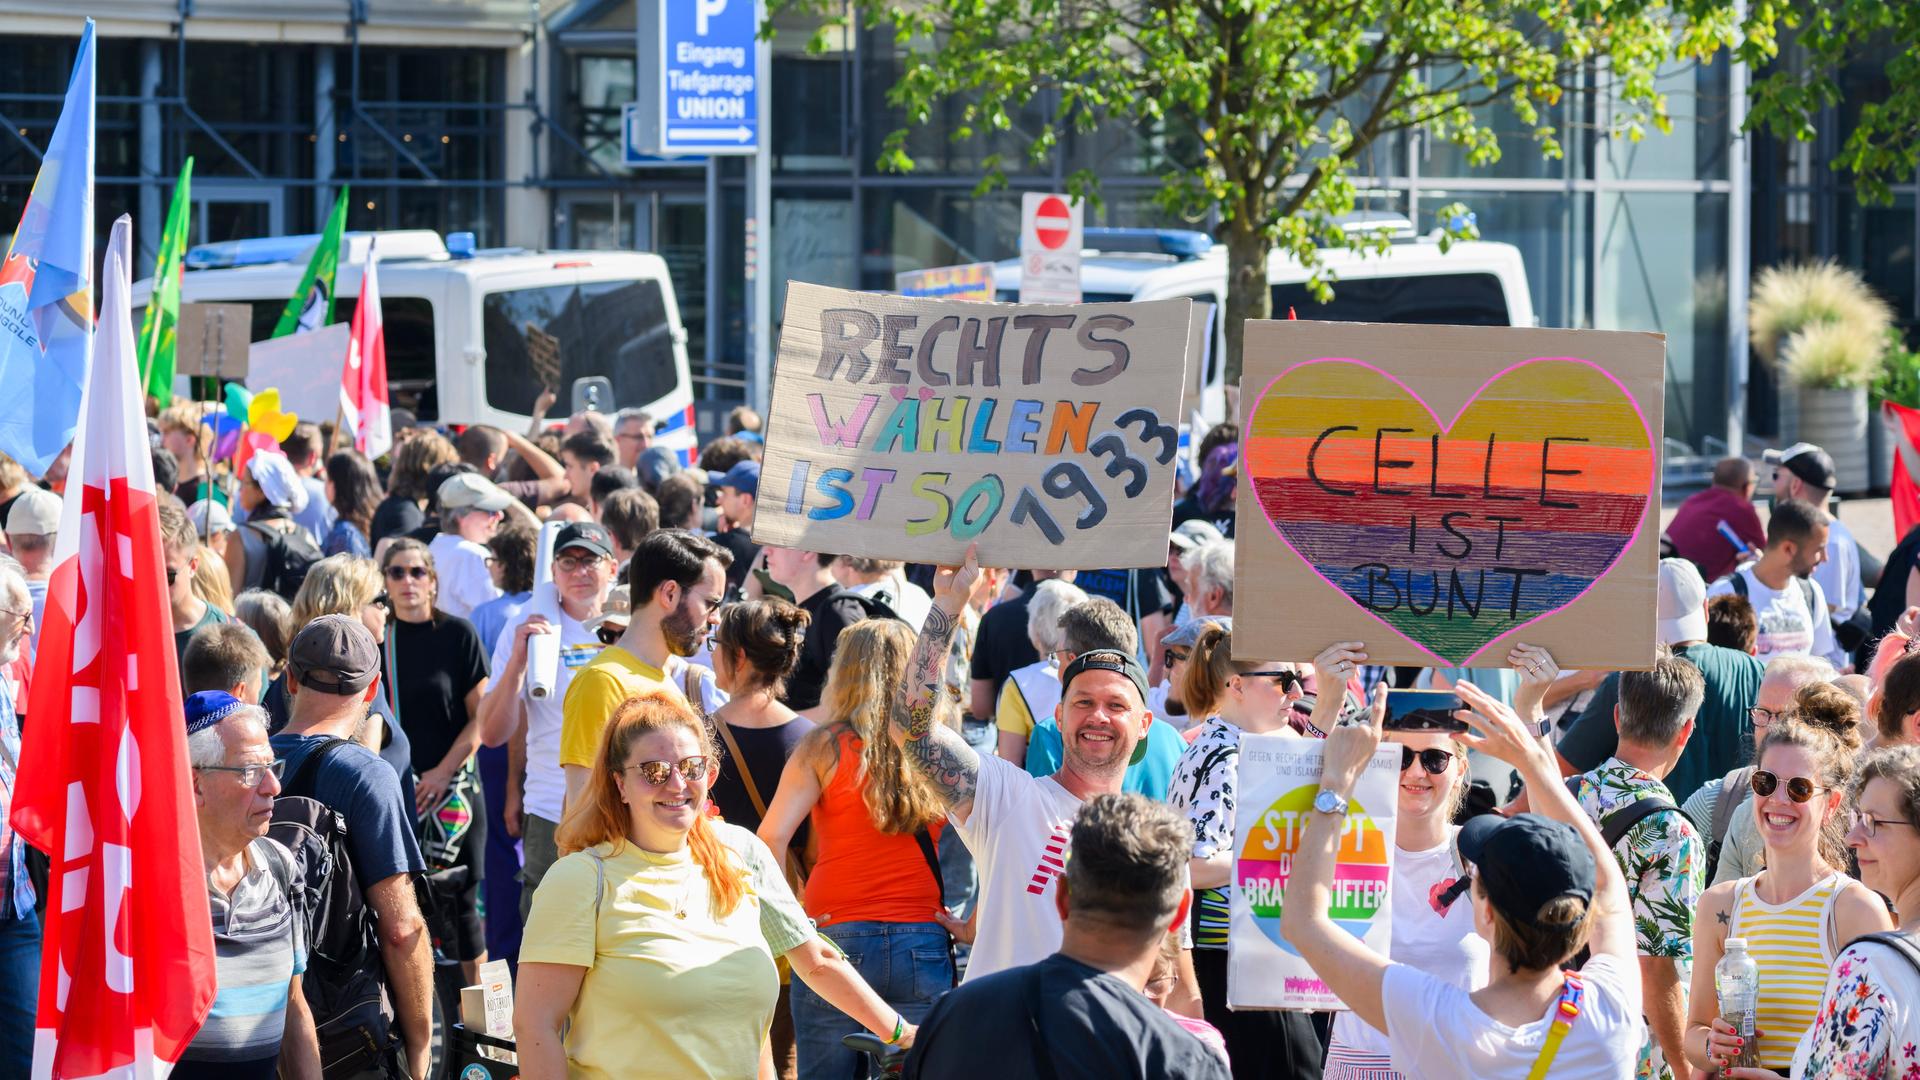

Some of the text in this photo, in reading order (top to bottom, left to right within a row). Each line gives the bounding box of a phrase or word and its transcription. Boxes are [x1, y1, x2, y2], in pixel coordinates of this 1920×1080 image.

[676, 41, 745, 68] Eingang
[668, 70, 754, 96] Tiefgarage
[677, 97, 745, 119] UNION
[813, 308, 1134, 388] RECHTS
[807, 385, 1101, 456] WÄHLEN
[785, 407, 1179, 546] IST SO 1933
[1307, 425, 1590, 510] CELLE
[1409, 511, 1524, 561] IST
[1352, 563, 1551, 621] BUNT
[1248, 750, 1272, 762] GEGEN
[1275, 765, 1291, 776] UND
[1263, 810, 1366, 852] STPT
[1245, 877, 1386, 908] BRAIFTER
